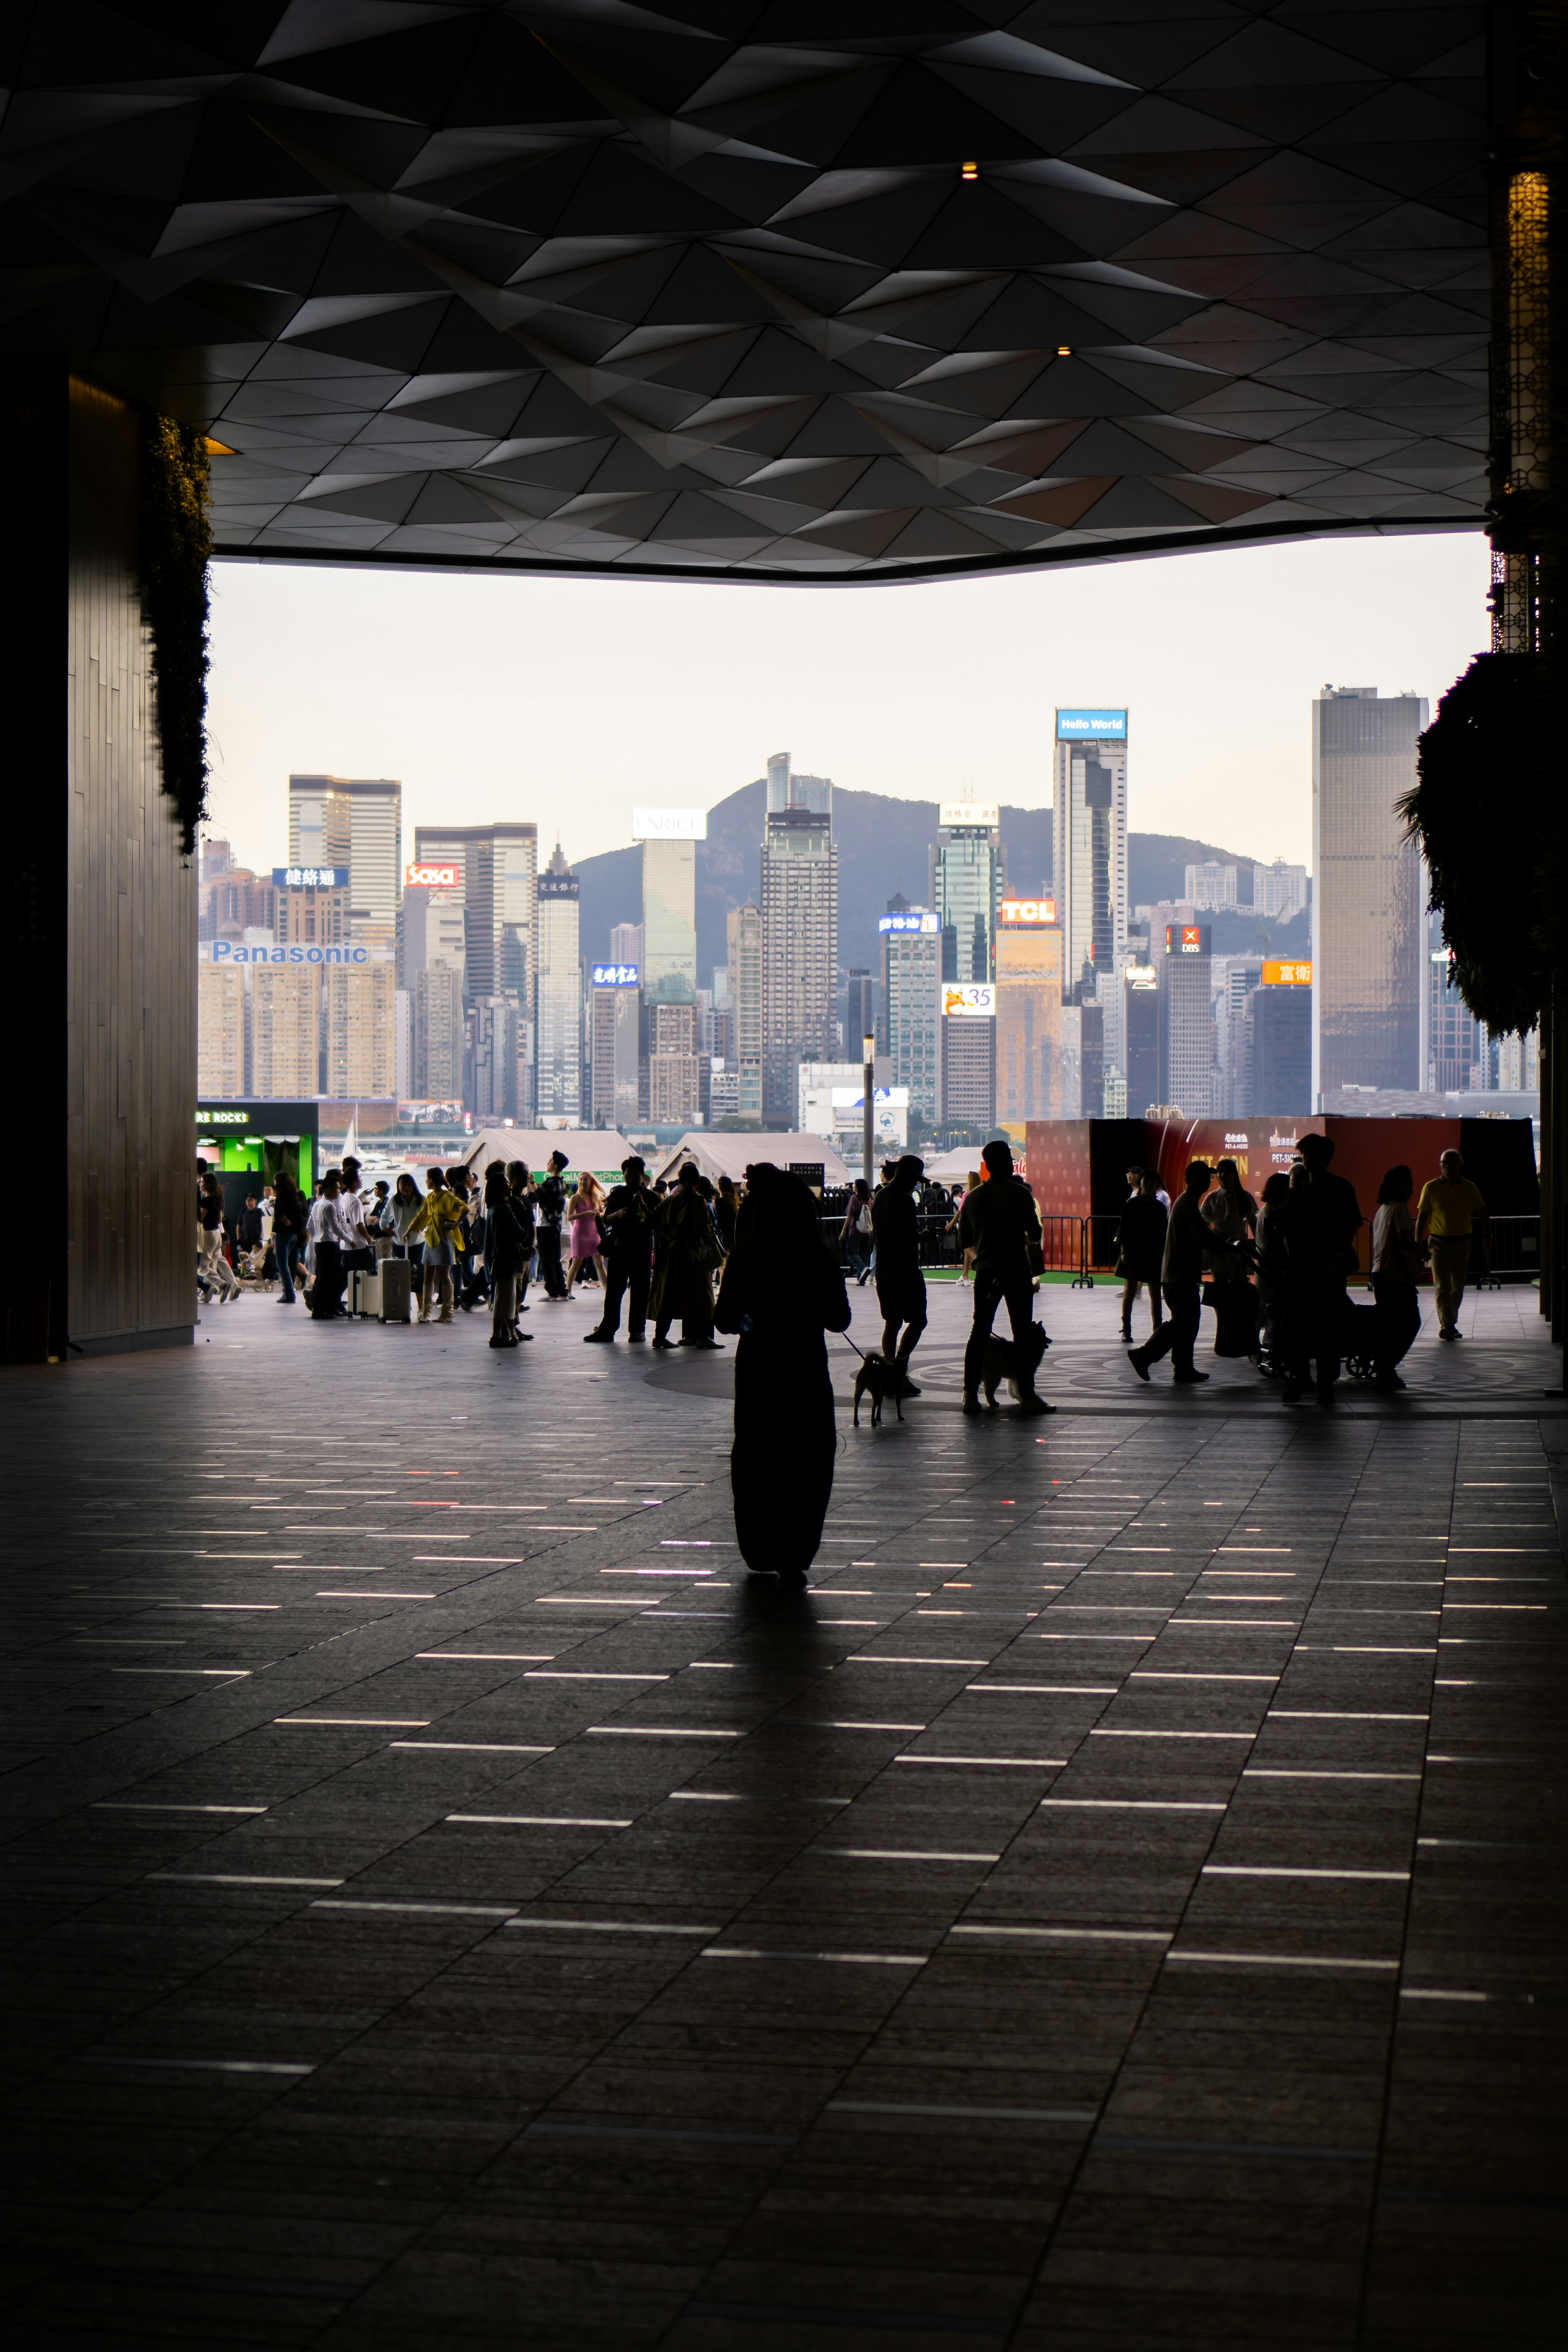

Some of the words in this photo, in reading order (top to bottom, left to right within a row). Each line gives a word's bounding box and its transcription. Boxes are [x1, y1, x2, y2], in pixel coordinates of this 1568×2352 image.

[1062, 719, 1089, 729] Hello
[1091, 719, 1123, 730] World
[637, 817, 703, 831] ENRICH
[285, 869, 335, 886] 健絡通
[540, 882, 579, 892] 交通銀行
[1002, 902, 1054, 920] TCL
[212, 941, 368, 964] Panasonic
[1182, 943, 1200, 953] DBS
[594, 966, 638, 984] 光明食品
[1280, 965, 1311, 981] 富衛
[967, 988, 990, 1006] 35
[213, 1111, 248, 1123] ROCKS
[1272, 1153, 1299, 1163] PET-SIO
